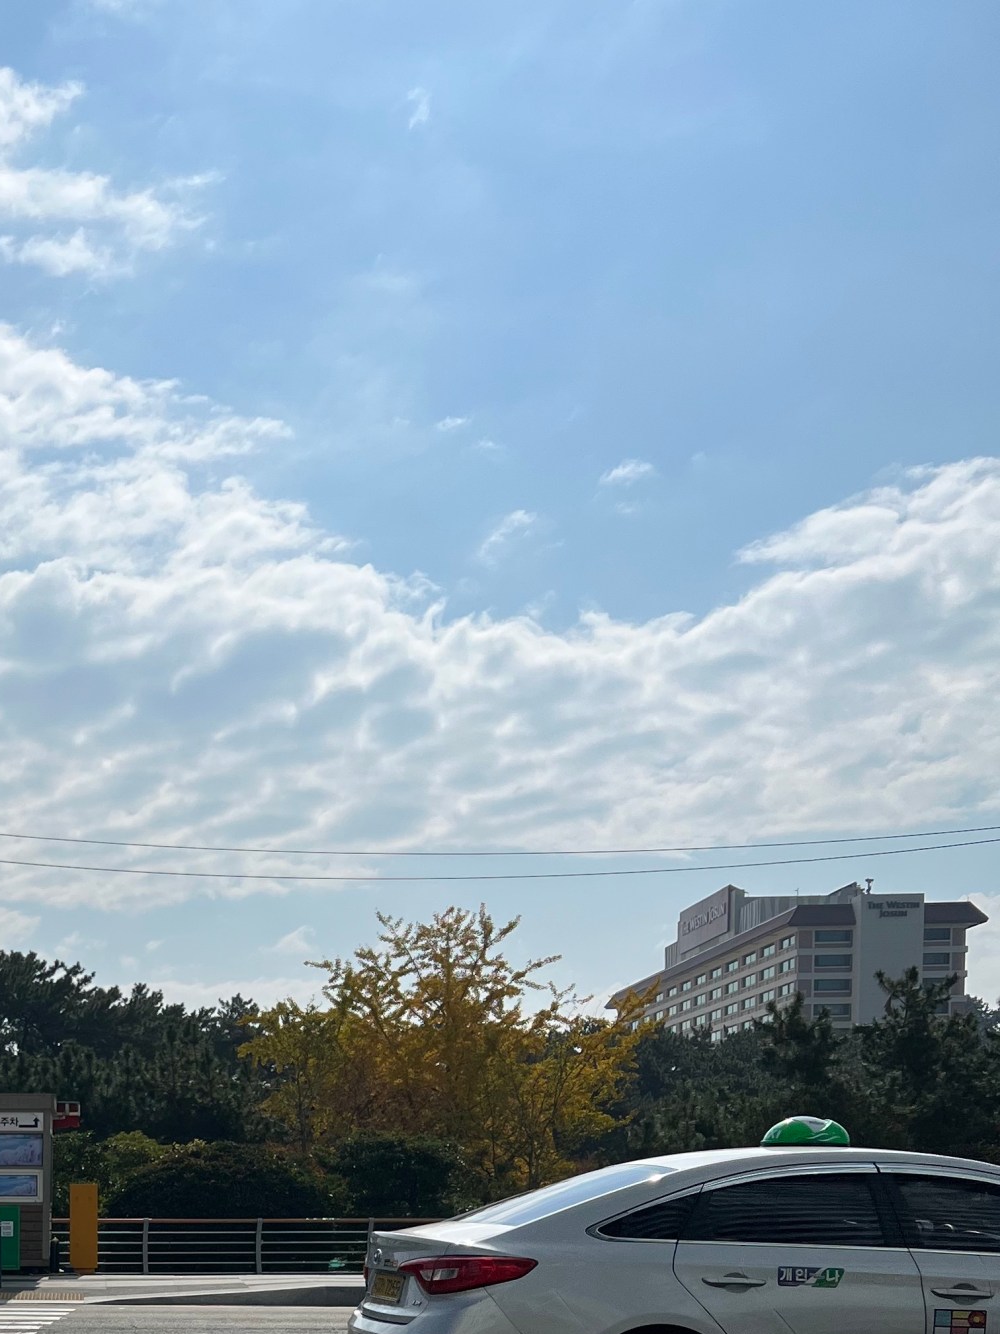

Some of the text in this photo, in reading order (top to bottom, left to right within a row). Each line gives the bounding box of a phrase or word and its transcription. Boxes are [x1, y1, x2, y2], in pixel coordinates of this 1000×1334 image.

[867, 901, 920, 910] THE WESTIN
[0, 1117, 19, 1127] 주차
[780, 1268, 808, 1281] 개인
